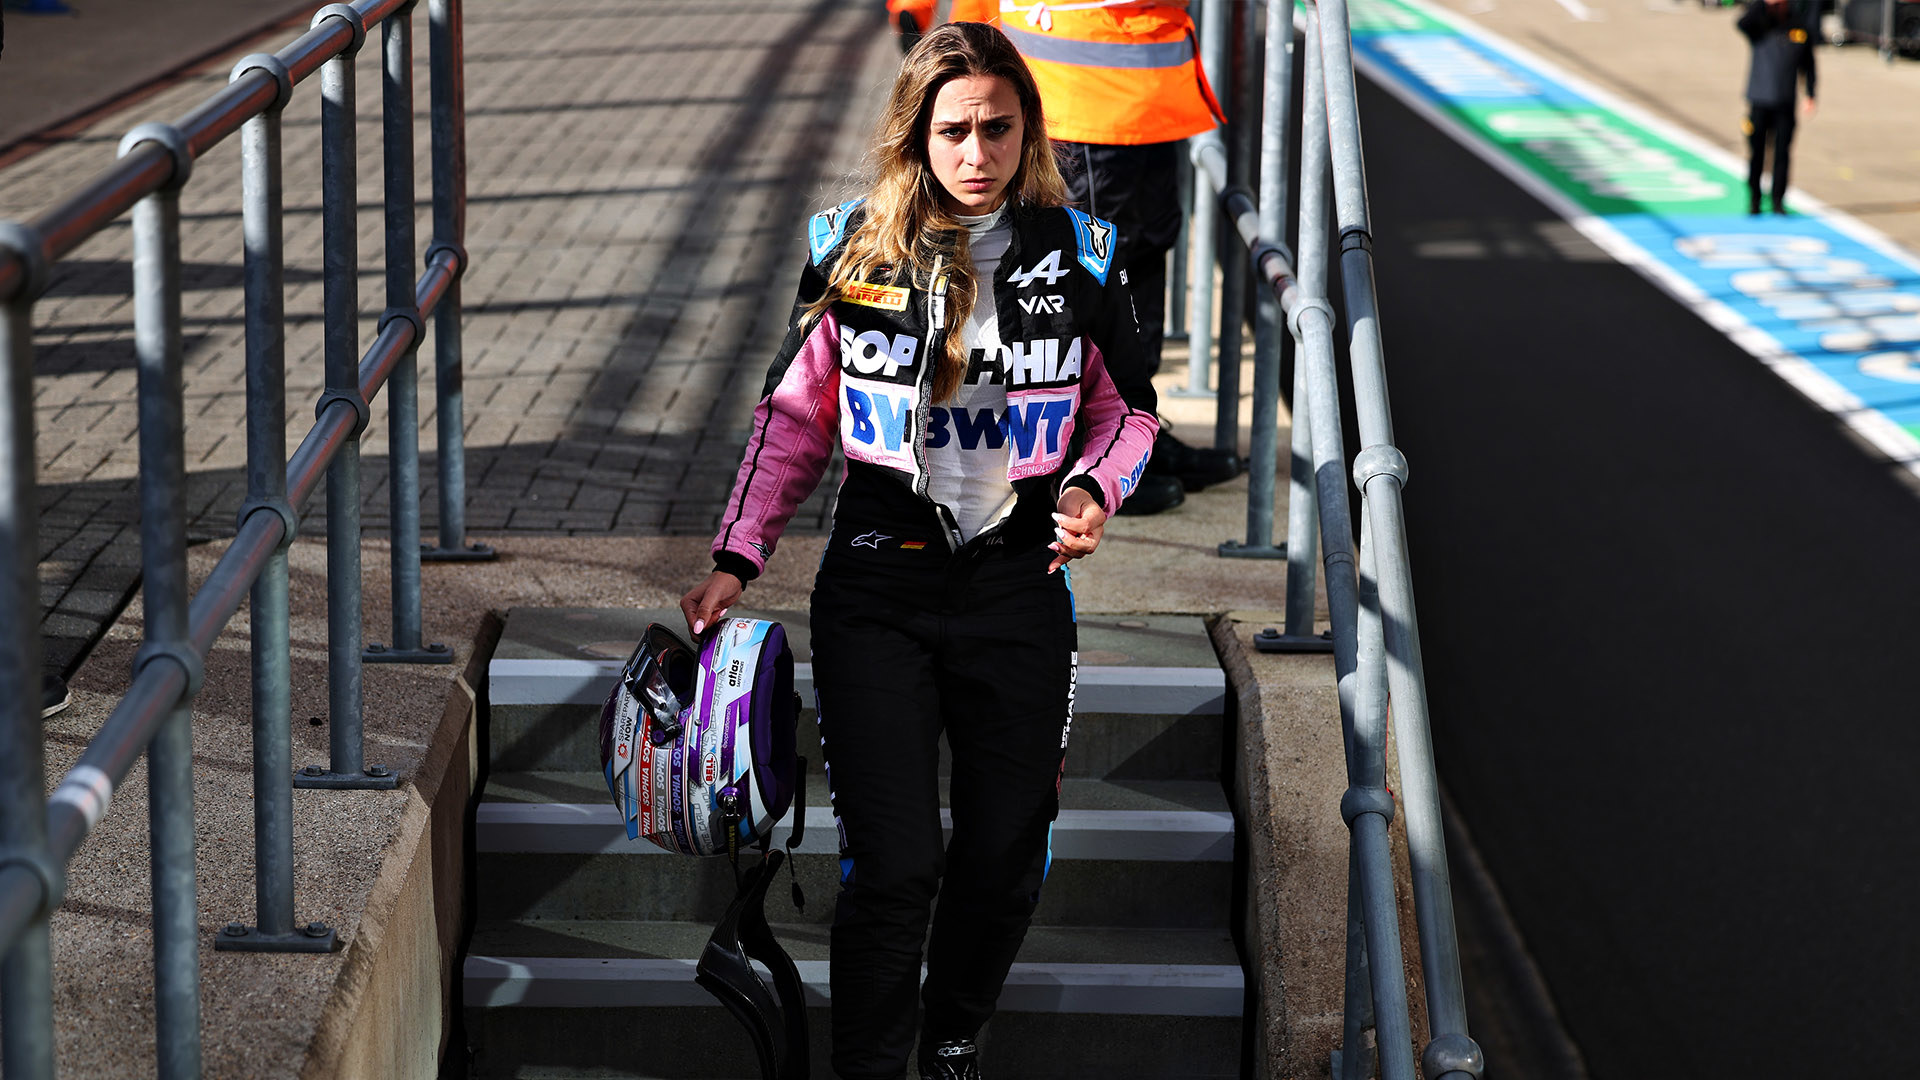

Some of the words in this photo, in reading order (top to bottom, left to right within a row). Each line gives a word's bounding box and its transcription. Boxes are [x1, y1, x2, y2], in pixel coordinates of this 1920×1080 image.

[1017, 294, 1065, 315] VAR
[840, 324, 918, 377] SOP
[728, 659, 740, 687] atlas
[624, 716, 633, 742] NOW
[642, 767, 650, 806] SOPHIA
[656, 750, 666, 789] SOPHIA
[706, 757, 714, 782] BELL
[672, 774, 681, 812] SOPHIA
[657, 795, 666, 832] SOPHIA
